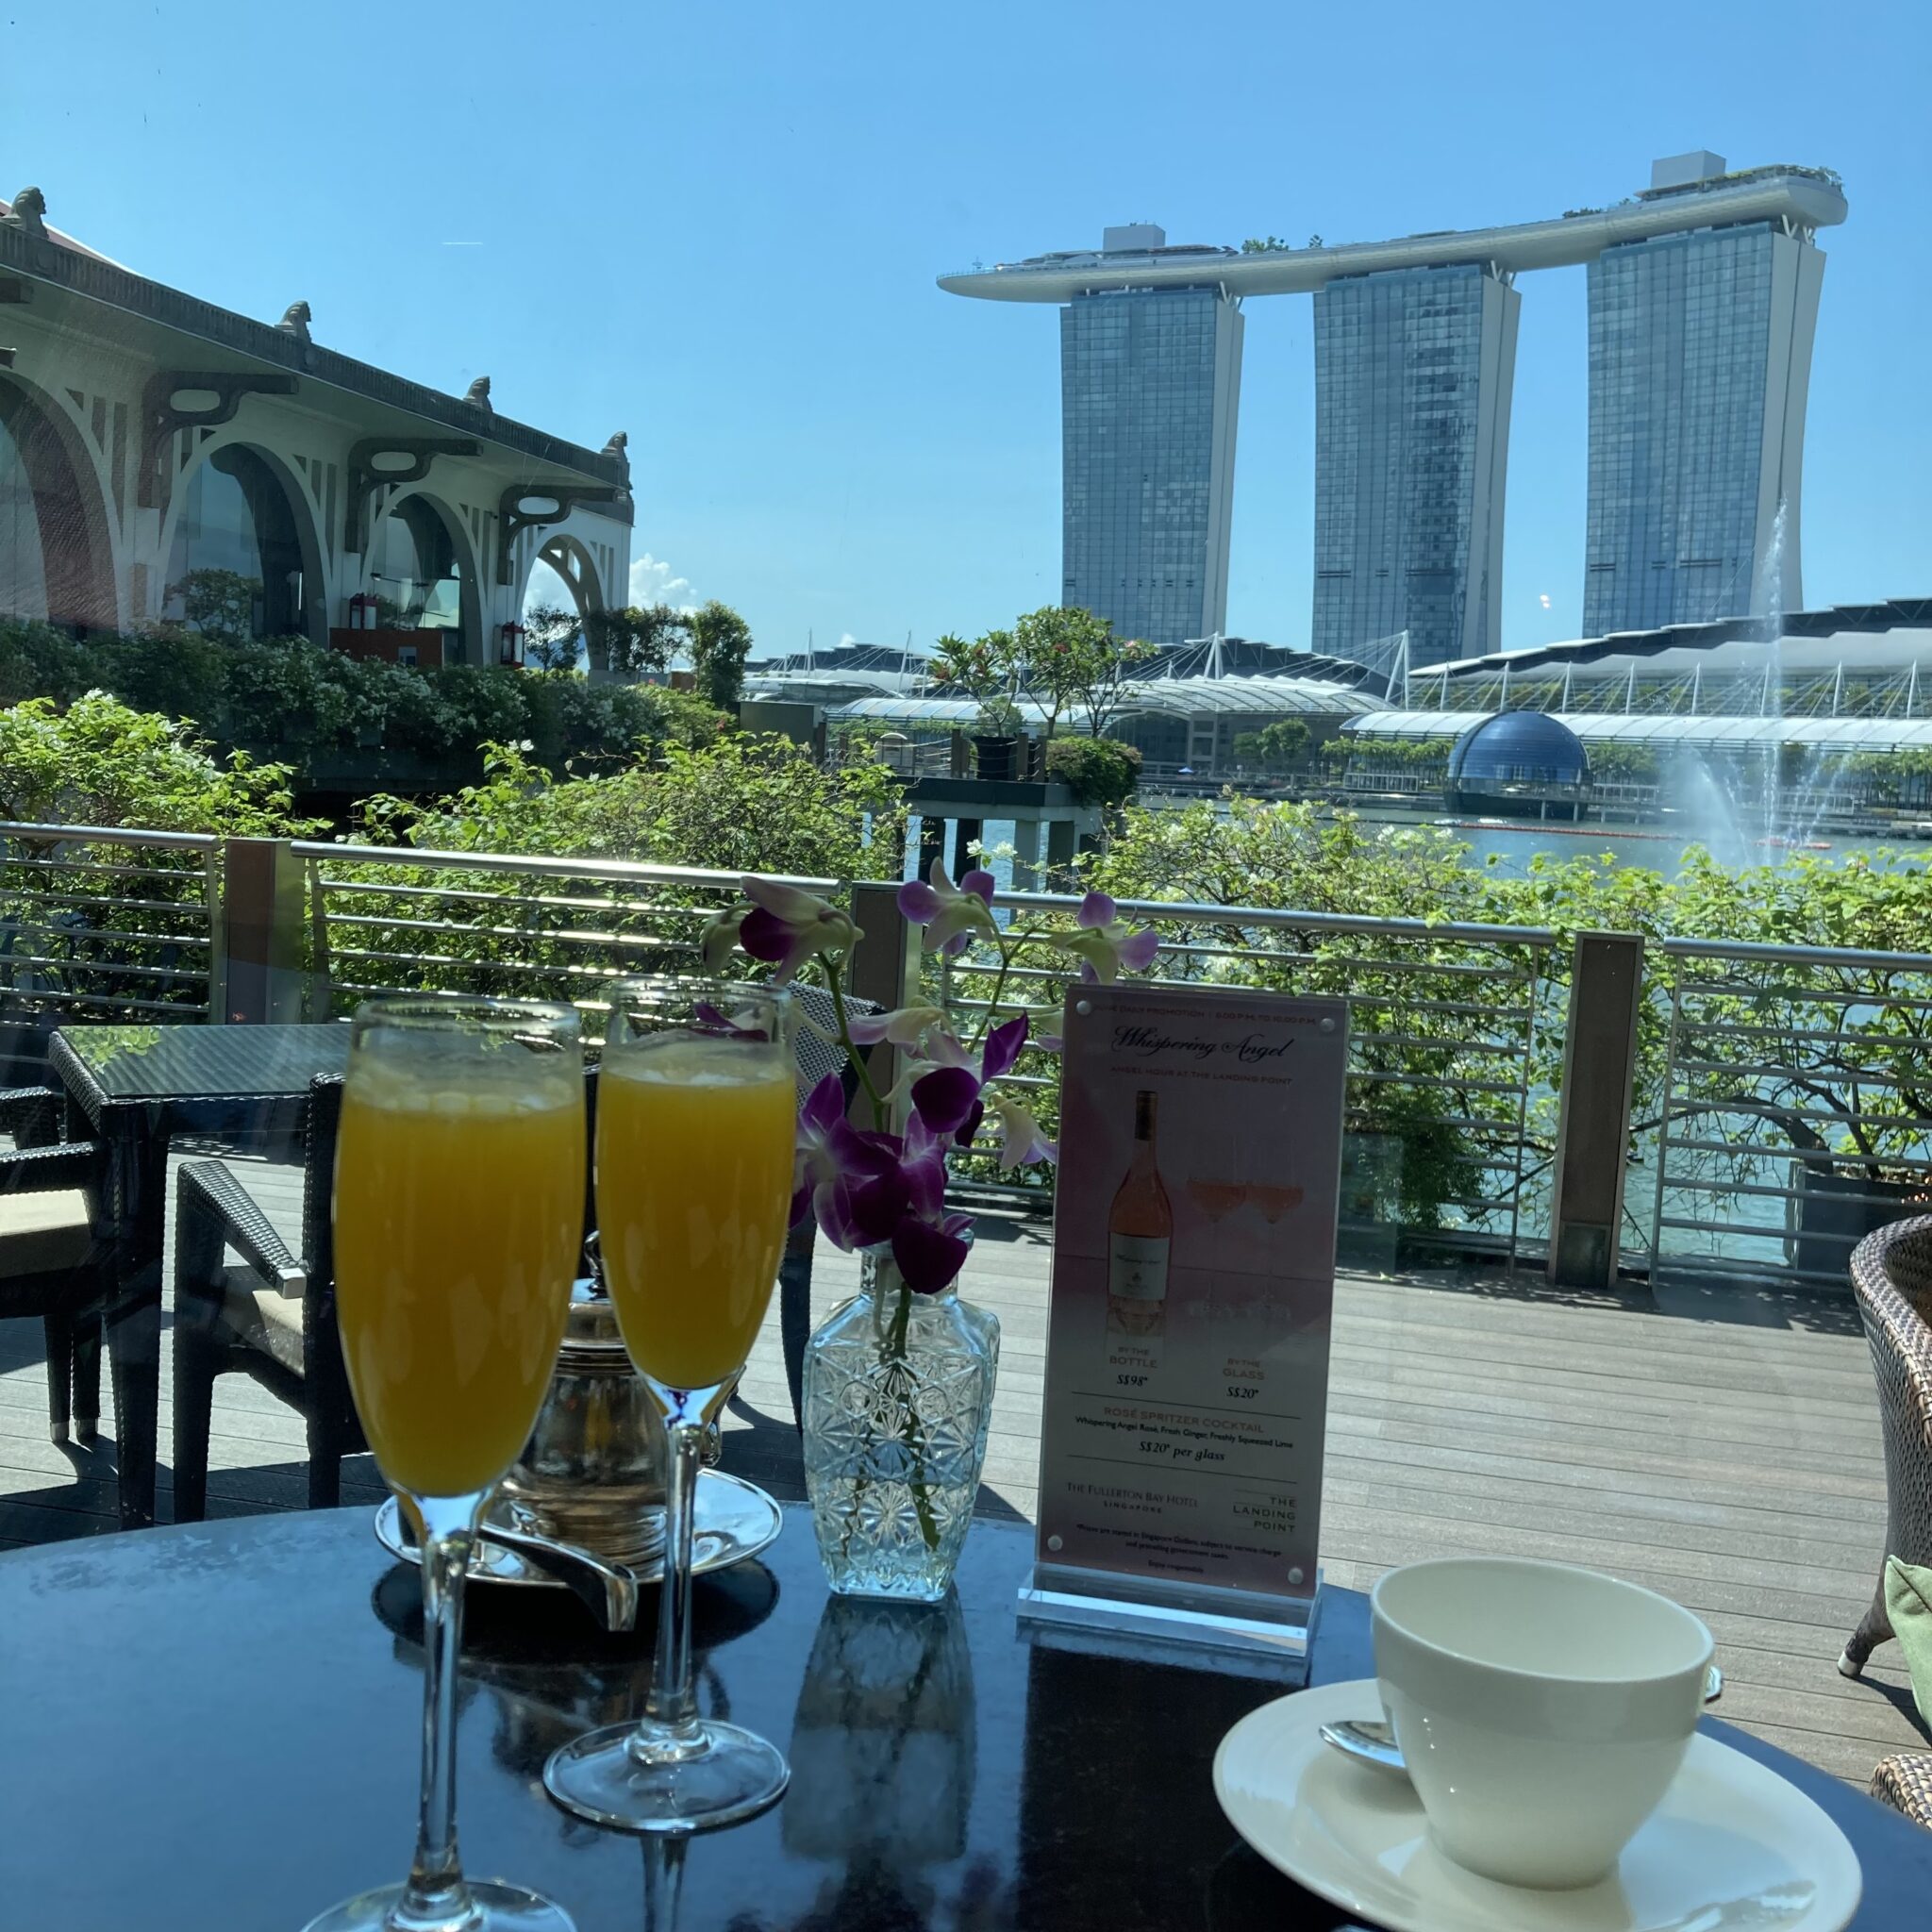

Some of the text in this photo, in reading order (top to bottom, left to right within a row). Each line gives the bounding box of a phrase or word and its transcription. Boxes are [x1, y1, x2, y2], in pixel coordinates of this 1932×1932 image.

[1147, 1007, 1205, 1018] PROMOTION
[1111, 1025, 1295, 1063] Whispering Angel
[1109, 1065, 1293, 1086] ANGEL HOUR AT THE LANDING POINT
[1118, 1346, 1150, 1356] BY THE
[1109, 1355, 1158, 1368] BOTTLE
[1227, 1357, 1260, 1368] BY THE
[1223, 1367, 1265, 1380] GLASS
[1140, 1410, 1199, 1425] SPRITZER
[1202, 1418, 1265, 1434] COCKTAIL
[1173, 1447, 1193, 1459] per
[1194, 1448, 1225, 1462] glass
[1066, 1481, 1199, 1508] THE FULLERTON BAY HOTEL
[1103, 1500, 1162, 1514] SINGAPORE
[1269, 1496, 1298, 1508] THE
[1232, 1505, 1297, 1521] LANDING
[1253, 1520, 1297, 1533] POINT
